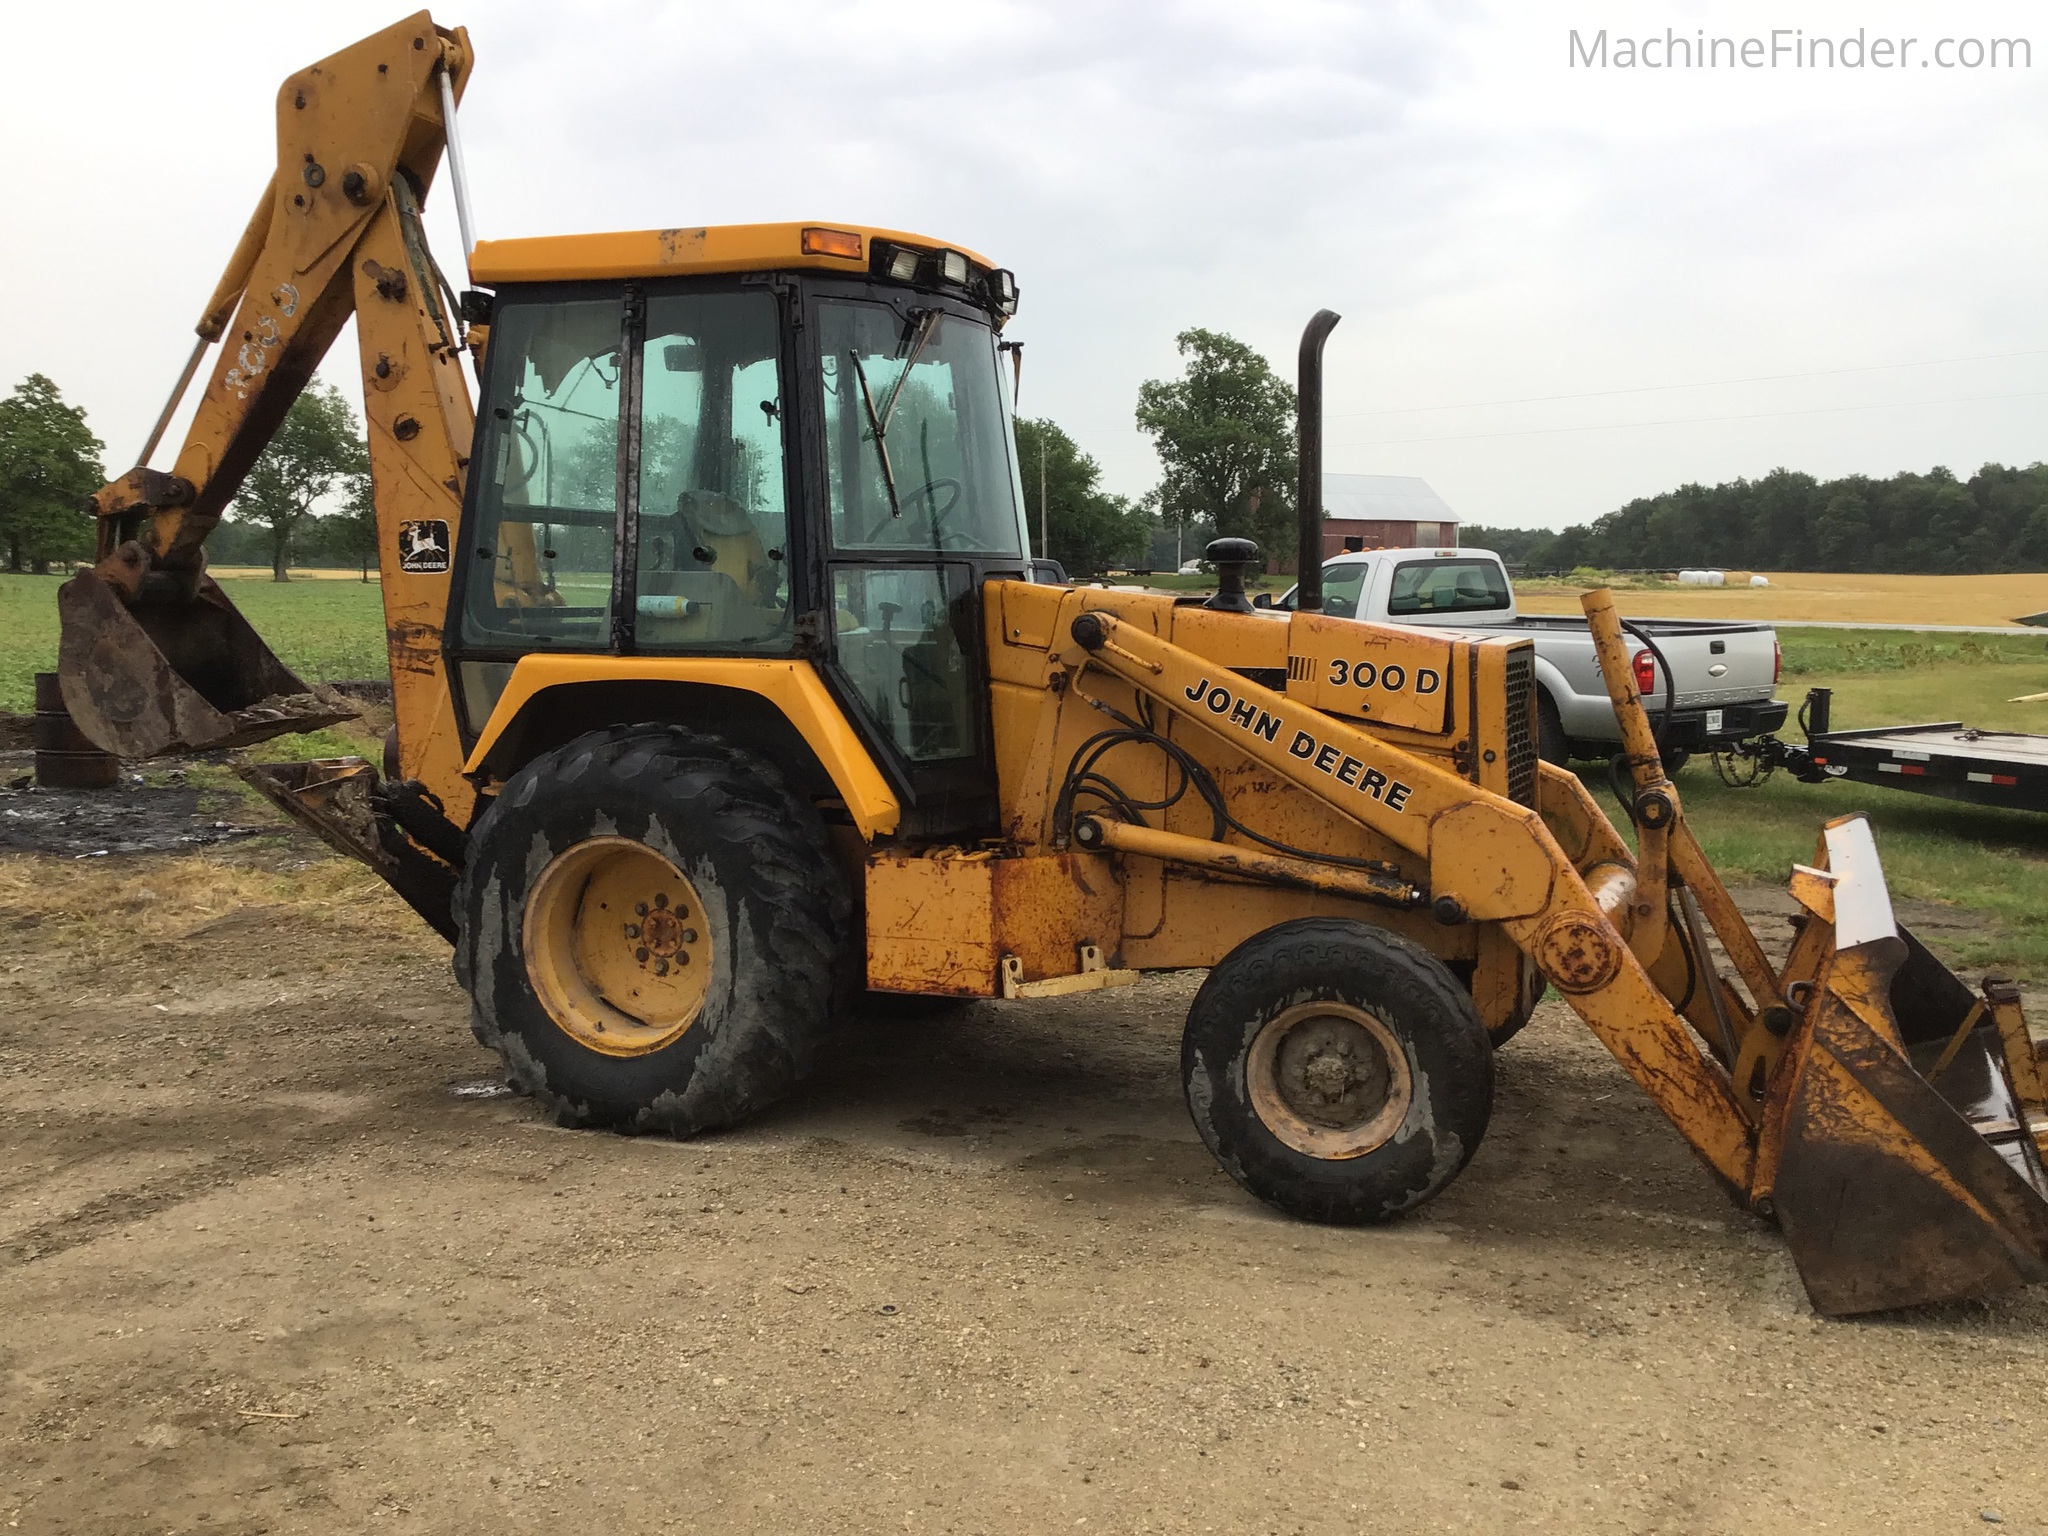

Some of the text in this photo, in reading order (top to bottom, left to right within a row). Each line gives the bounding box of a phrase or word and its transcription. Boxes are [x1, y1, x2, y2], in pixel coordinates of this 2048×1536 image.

[402, 562, 447, 570] JOHN DEERE
[1185, 677, 1413, 813] JOHN DEERE
